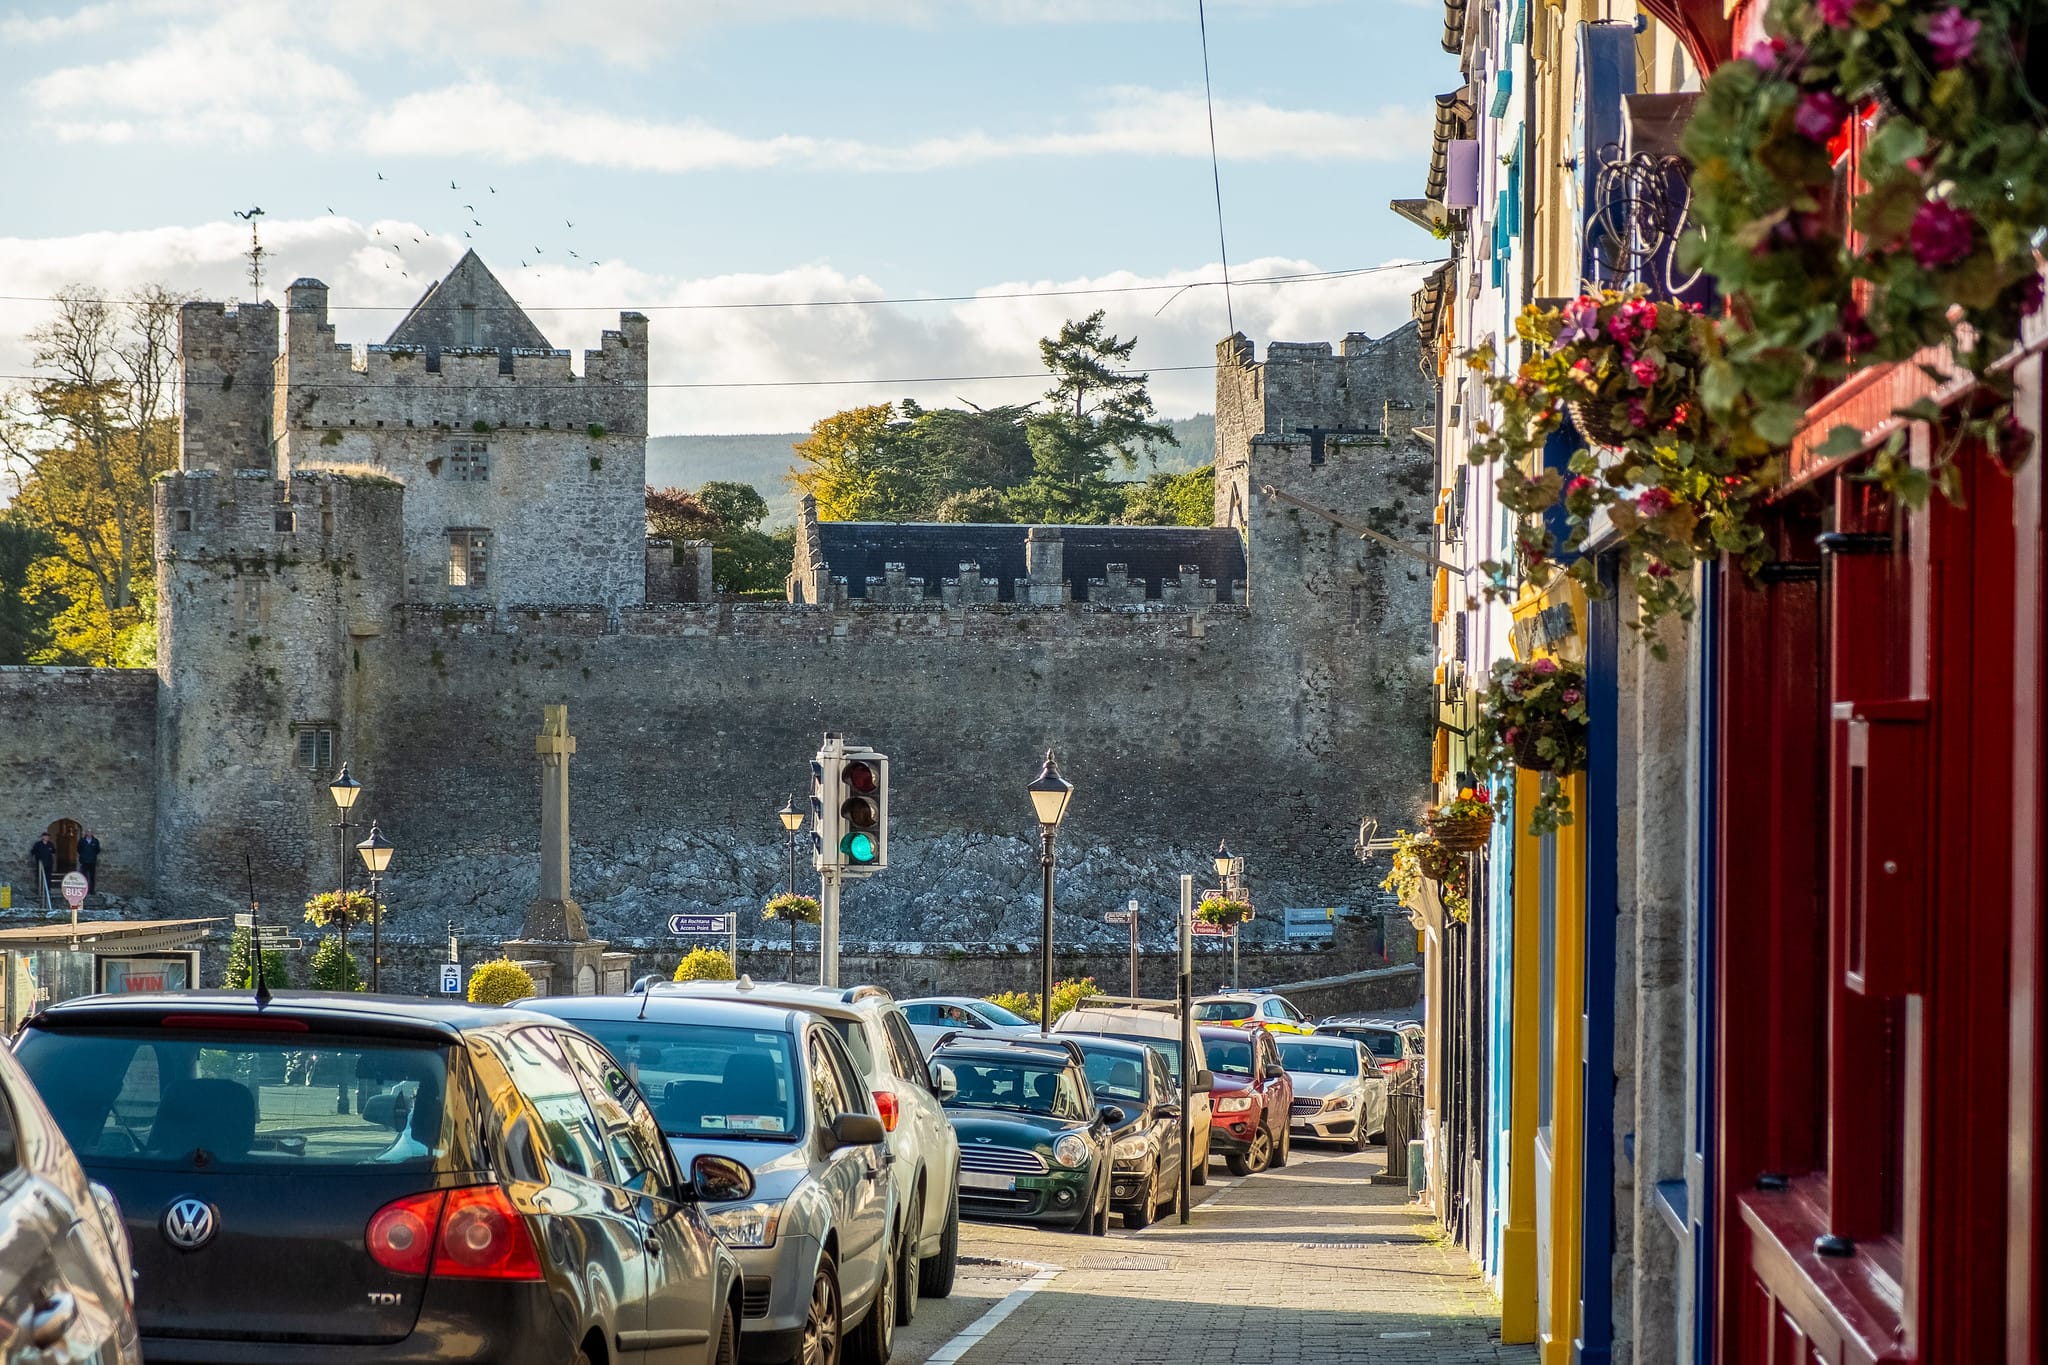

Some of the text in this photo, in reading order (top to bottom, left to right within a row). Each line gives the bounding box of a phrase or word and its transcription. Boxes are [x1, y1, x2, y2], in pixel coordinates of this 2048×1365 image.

[66, 887, 83, 897] BUS
[125, 975, 165, 993] WIN
[446, 978, 457, 991] P
[168, 1200, 211, 1244] VW
[368, 1293, 402, 1306] TDI
